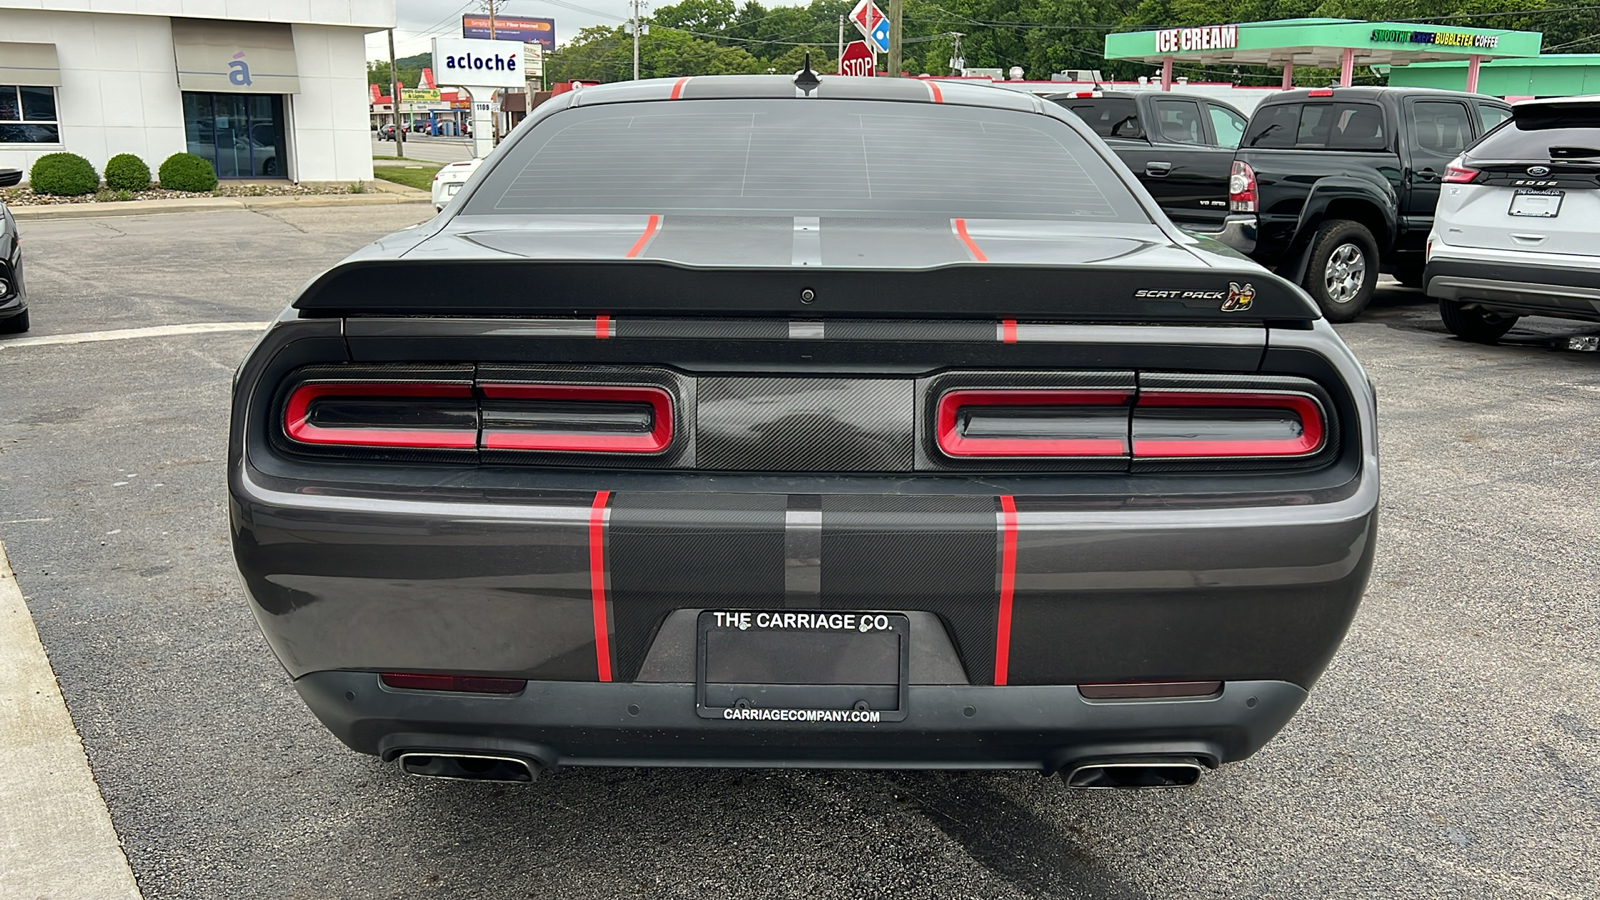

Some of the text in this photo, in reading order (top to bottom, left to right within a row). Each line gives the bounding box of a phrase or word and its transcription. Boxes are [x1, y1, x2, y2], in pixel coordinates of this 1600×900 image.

[1156, 26, 1238, 52] ICE CREAM
[1475, 34, 1499, 47] COFFEE
[228, 50, 253, 86] á
[446, 52, 516, 71] acloché
[843, 57, 873, 77] STOP
[1135, 290, 1226, 299] SCAT PACK
[713, 612, 893, 630] THE CARRIAGE CO.
[723, 708, 880, 722] CARRIAGECOMPANY.COM
